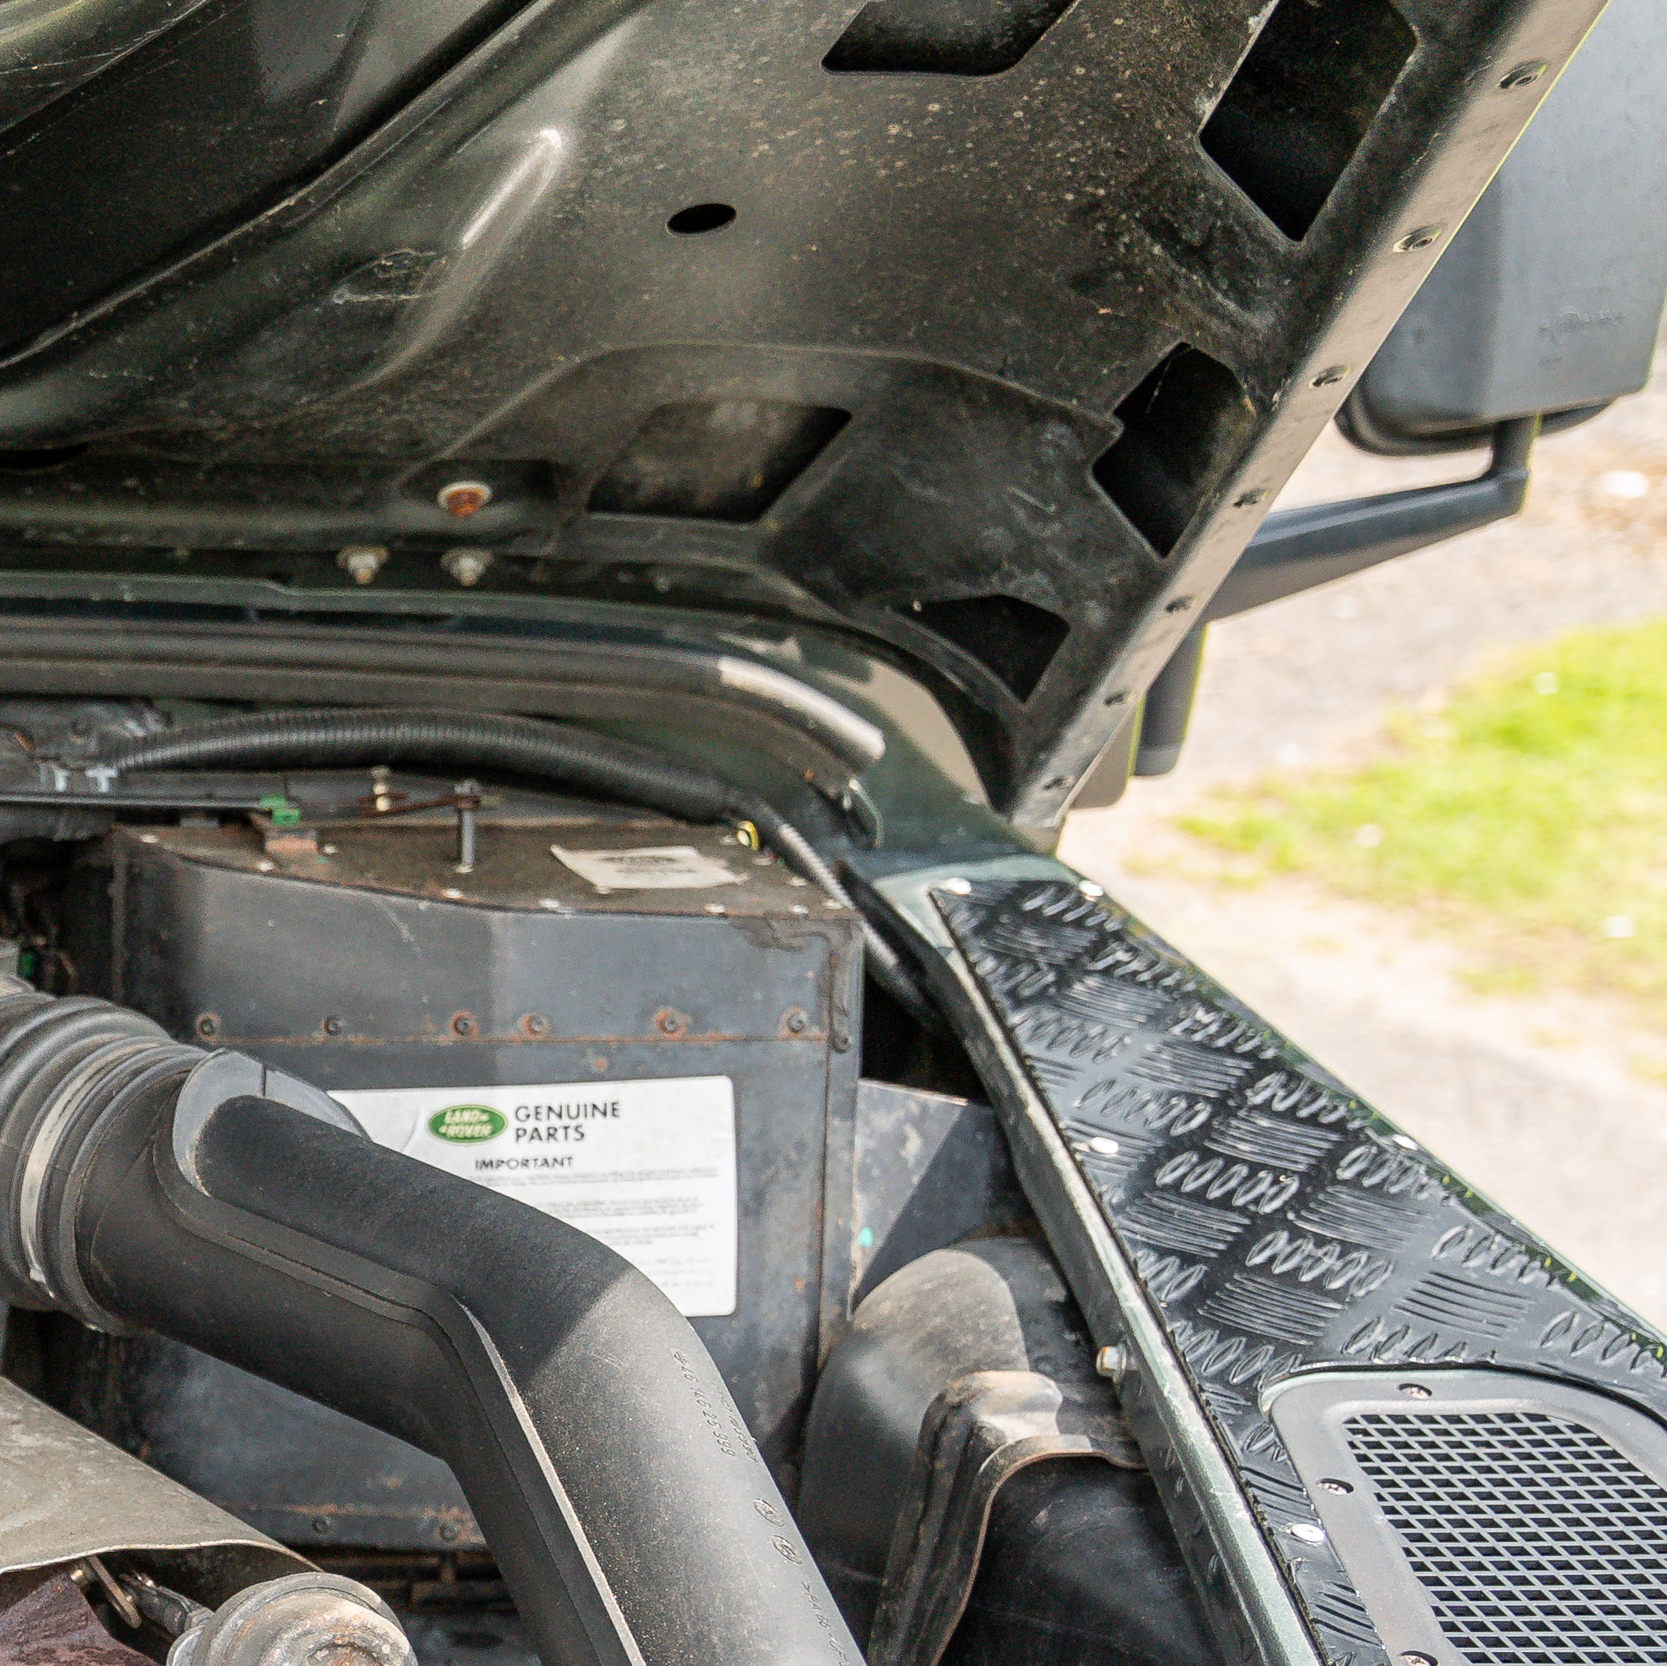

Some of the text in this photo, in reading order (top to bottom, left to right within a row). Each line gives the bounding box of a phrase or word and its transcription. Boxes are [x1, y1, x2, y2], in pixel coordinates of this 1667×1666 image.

[515, 1101, 621, 1122] GENUINE
[515, 1124, 586, 1143] PARTS
[475, 1155, 574, 1171] IMPORTANT
